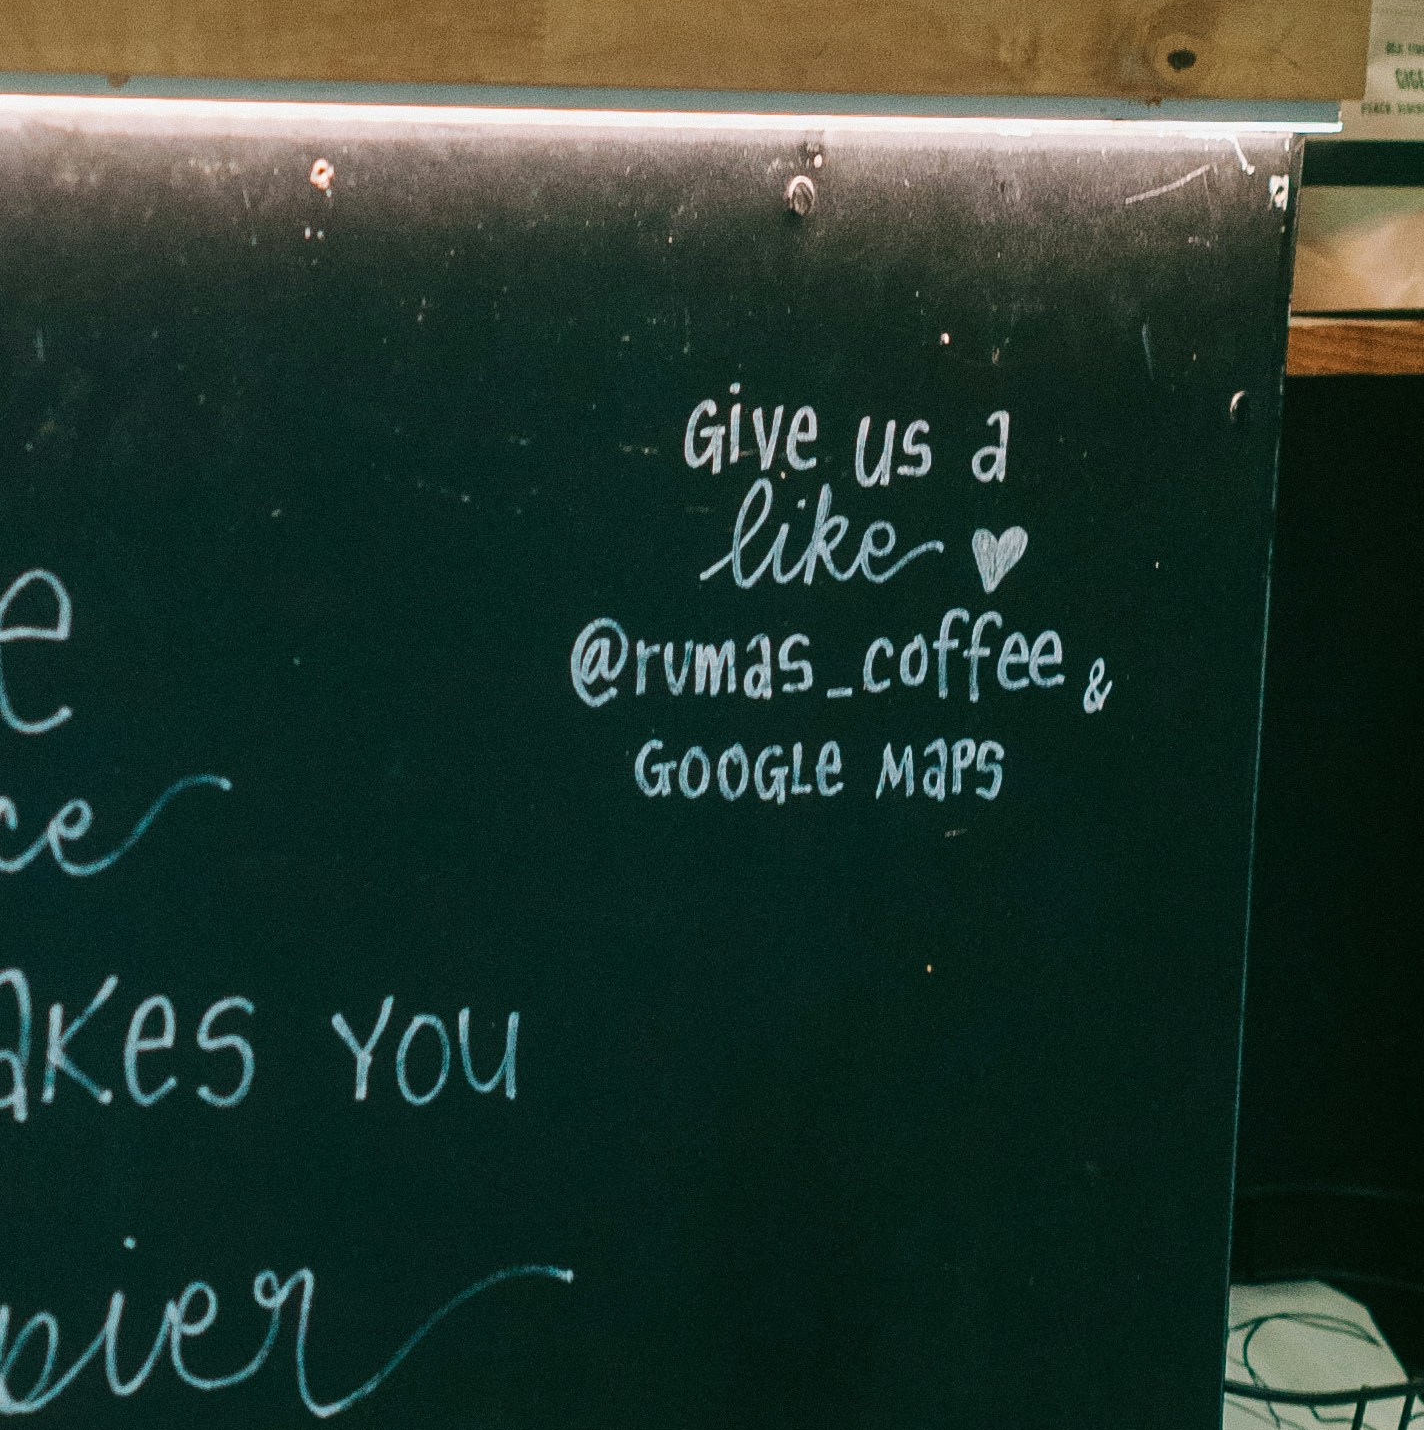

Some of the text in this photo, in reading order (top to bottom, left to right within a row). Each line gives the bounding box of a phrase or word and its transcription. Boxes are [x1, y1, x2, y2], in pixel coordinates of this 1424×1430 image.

[683, 382, 1011, 488] Give us a
[698, 477, 945, 590] like
[570, 607, 1114, 714] @rumas_coffee &
[330, 995, 521, 1106] YOU
